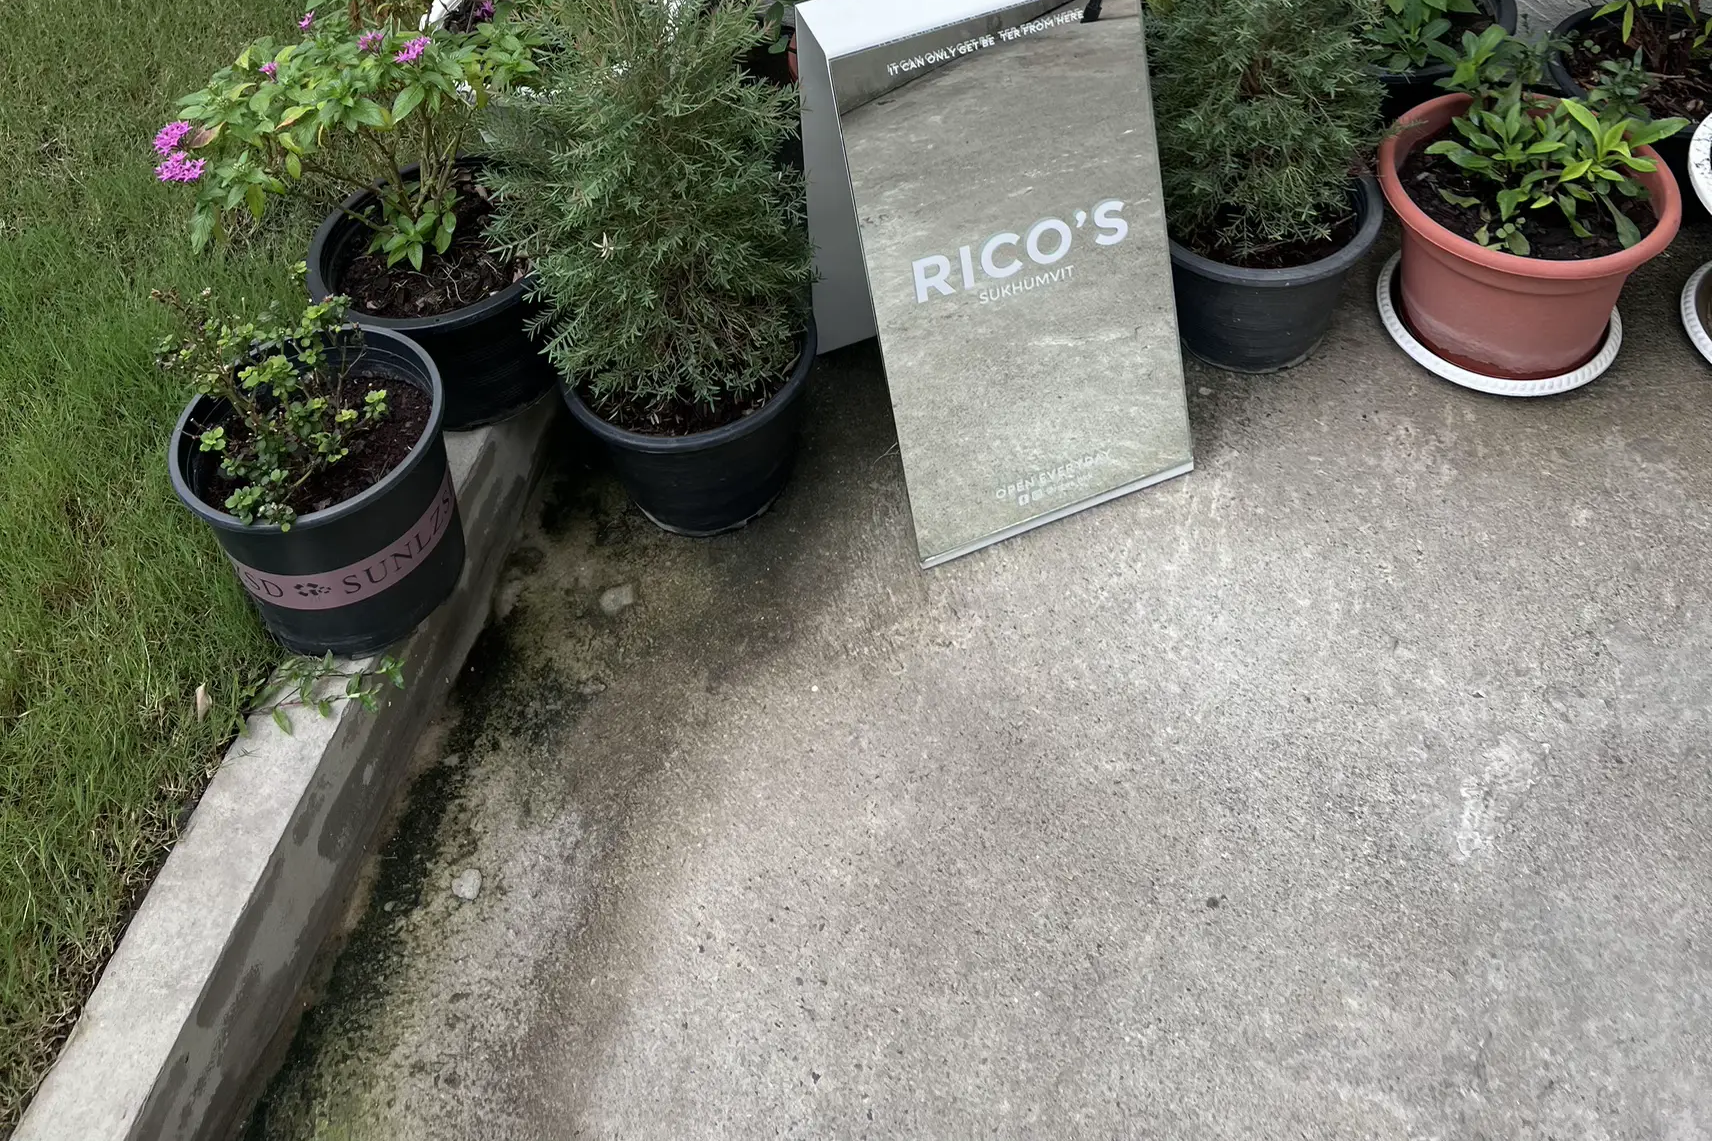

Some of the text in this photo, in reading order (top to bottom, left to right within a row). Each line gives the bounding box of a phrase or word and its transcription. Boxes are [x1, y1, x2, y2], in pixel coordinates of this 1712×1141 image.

[902, 56, 926, 73] CAN
[927, 47, 957, 65] ONLY
[958, 42, 980, 56] GET
[1023, 20, 1055, 36] FROM
[1057, 10, 1085, 26] HERE
[978, 264, 1075, 305] SUKHUMVIT
[996, 476, 1035, 499] OPEN
[1039, 449, 1112, 484] EVERYDAY
